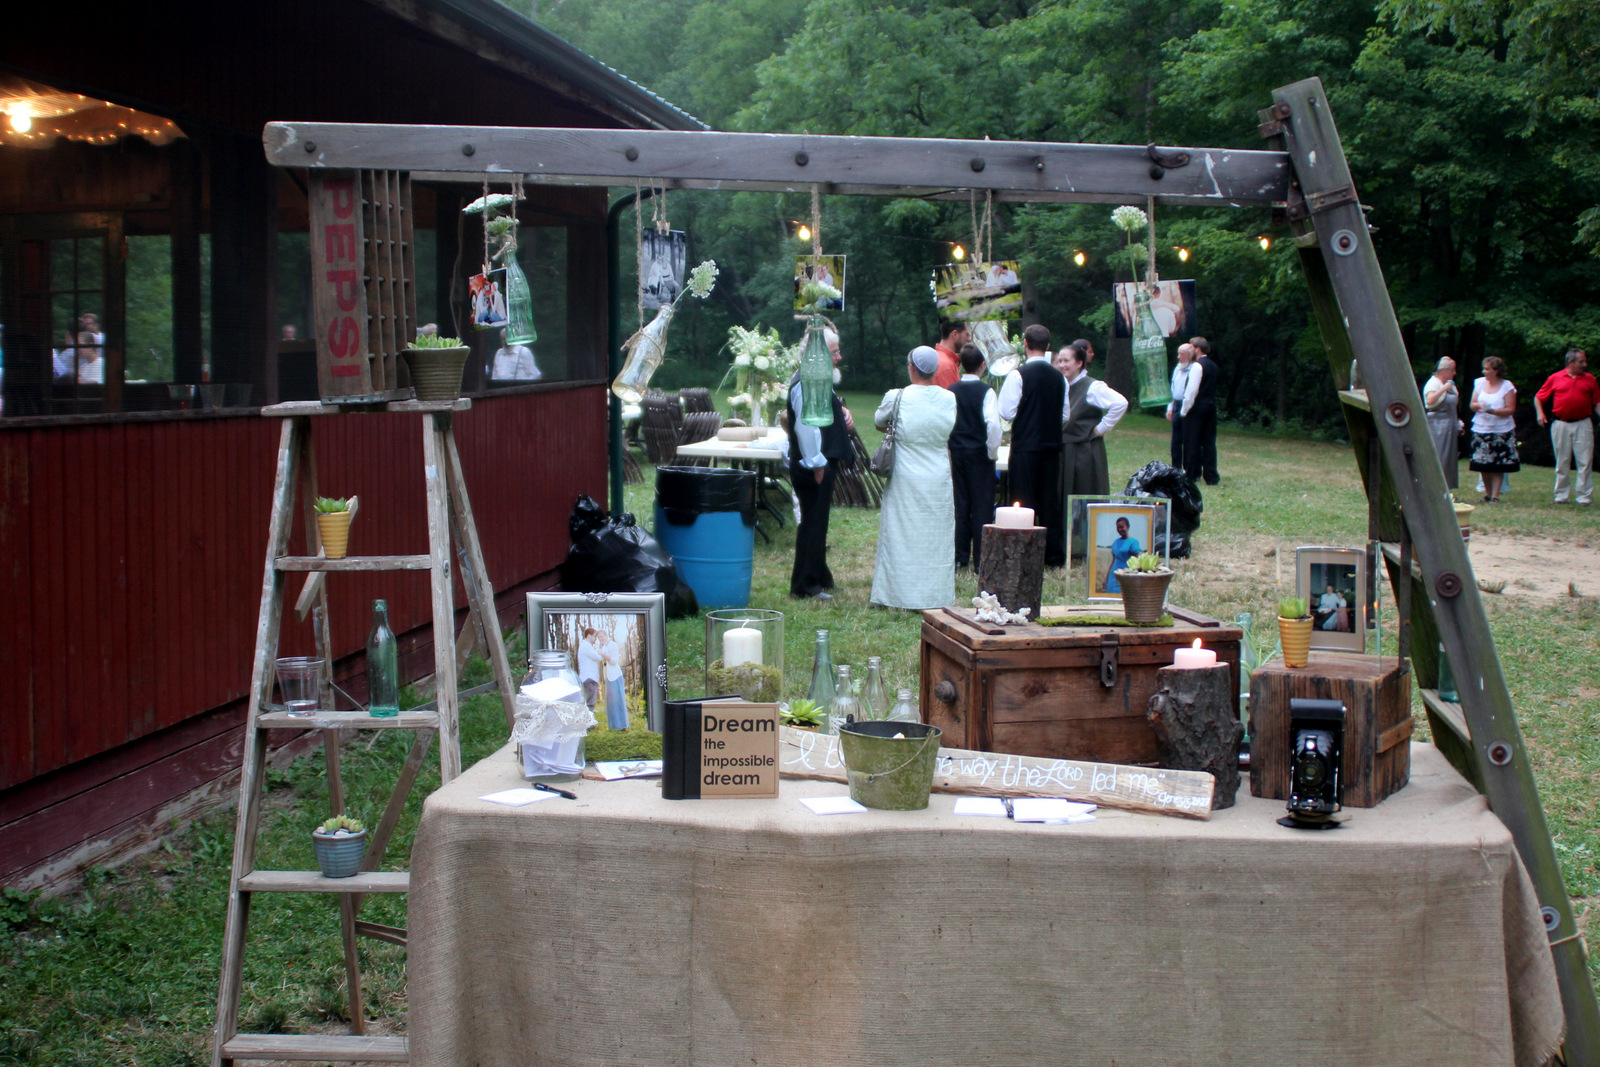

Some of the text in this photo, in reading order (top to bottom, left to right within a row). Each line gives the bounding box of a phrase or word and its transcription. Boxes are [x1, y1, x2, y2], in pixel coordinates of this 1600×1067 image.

[323, 178, 361, 378] PEPSI
[703, 715, 775, 732] Dream
[703, 738, 726, 750] the
[703, 755, 775, 769] impossible
[703, 771, 760, 785] dream
[1000, 755, 1041, 787] the
[1090, 765, 1117, 793] led
